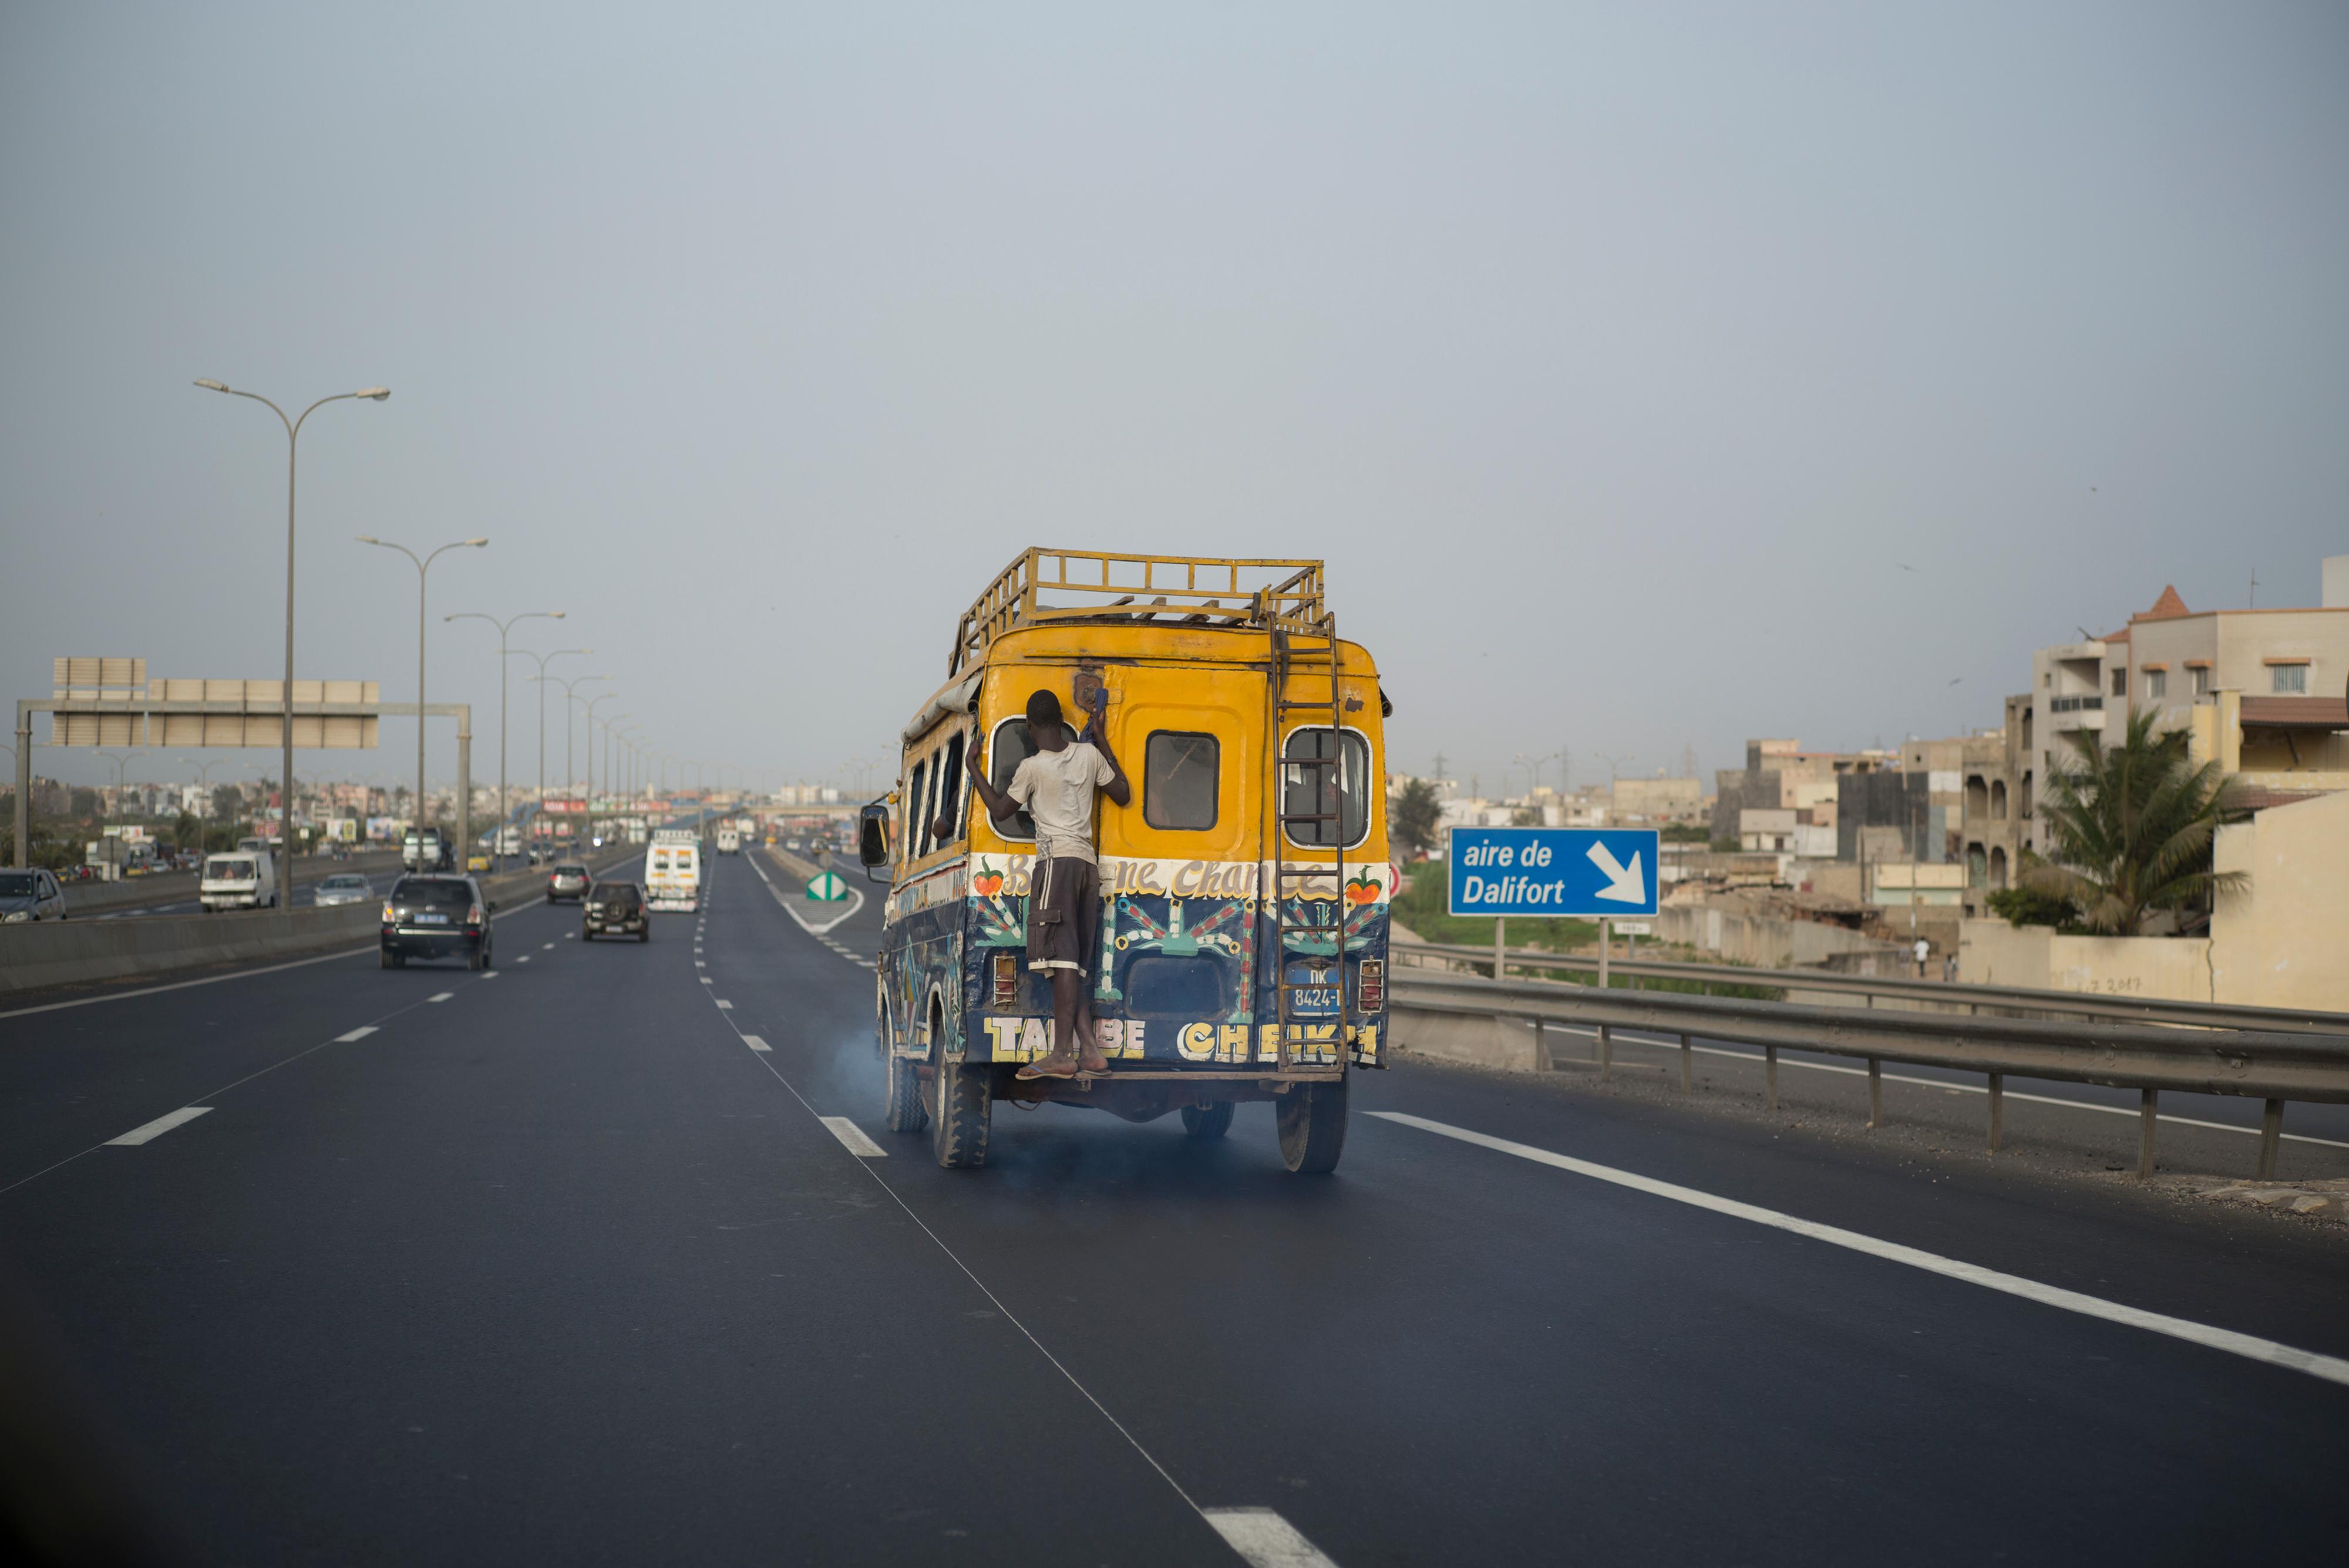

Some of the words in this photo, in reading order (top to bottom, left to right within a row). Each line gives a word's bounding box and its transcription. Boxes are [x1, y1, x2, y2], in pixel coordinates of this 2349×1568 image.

[1464, 839, 1513, 867] aire
[1520, 840, 1552, 867] de
[1002, 854, 1166, 896] Bne
[1463, 876, 1564, 904] Dalifort
[1310, 970, 1327, 984] DK
[1177, 1021, 1381, 1065] CHEIKH
